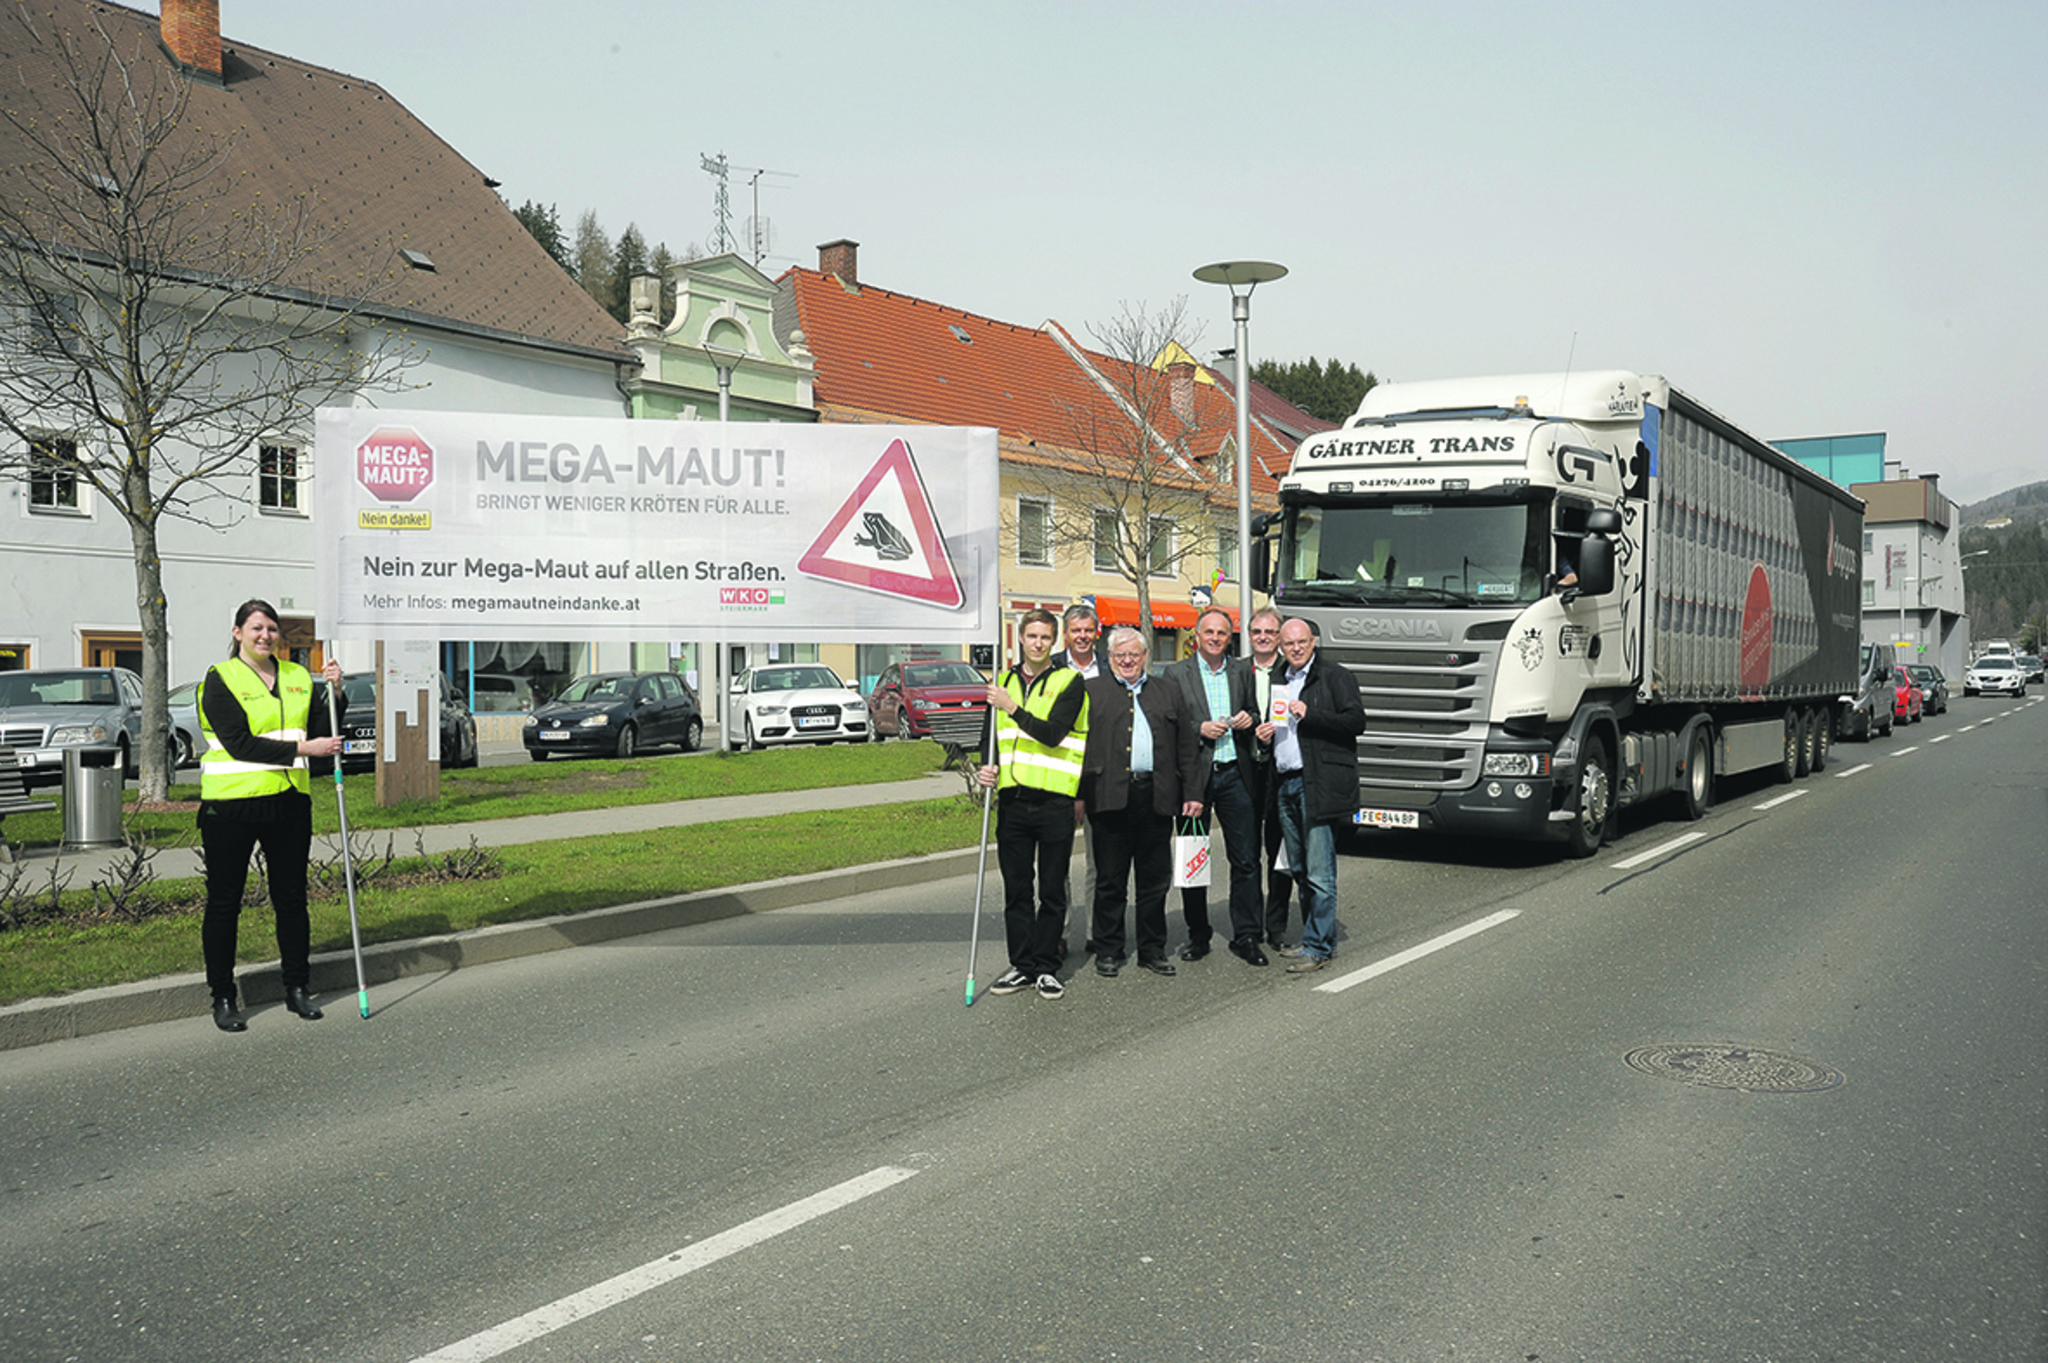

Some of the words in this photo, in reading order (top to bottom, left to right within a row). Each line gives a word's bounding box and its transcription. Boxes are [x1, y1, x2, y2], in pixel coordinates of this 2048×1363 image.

[363, 445, 429, 466] MEGA-
[1309, 438, 1415, 459] GÄRTNER
[1430, 436, 1515, 452] TRANS
[476, 440, 785, 488] MEGA-MAUT!
[363, 466, 429, 486] MAUT?
[476, 494, 541, 511] BRINGT
[545, 495, 626, 512] WENIGER
[630, 494, 699, 514] KRÖTEN
[705, 495, 738, 514] FÜR
[742, 499, 789, 515] ALLE.
[362, 511, 387, 526] Nein
[389, 512, 427, 527] danke!
[363, 556, 414, 577] Nein
[421, 560, 456, 577] zur
[464, 557, 589, 583] Mega-Maut
[594, 559, 629, 580] auf
[635, 560, 688, 580] allen
[695, 560, 786, 582] Straßen.
[363, 593, 403, 609] Mehr
[407, 594, 447, 609] Infos:
[451, 595, 641, 613] megamautneindanke.at
[721, 588, 768, 604] WKO
[1338, 617, 1443, 639] SCANIA
